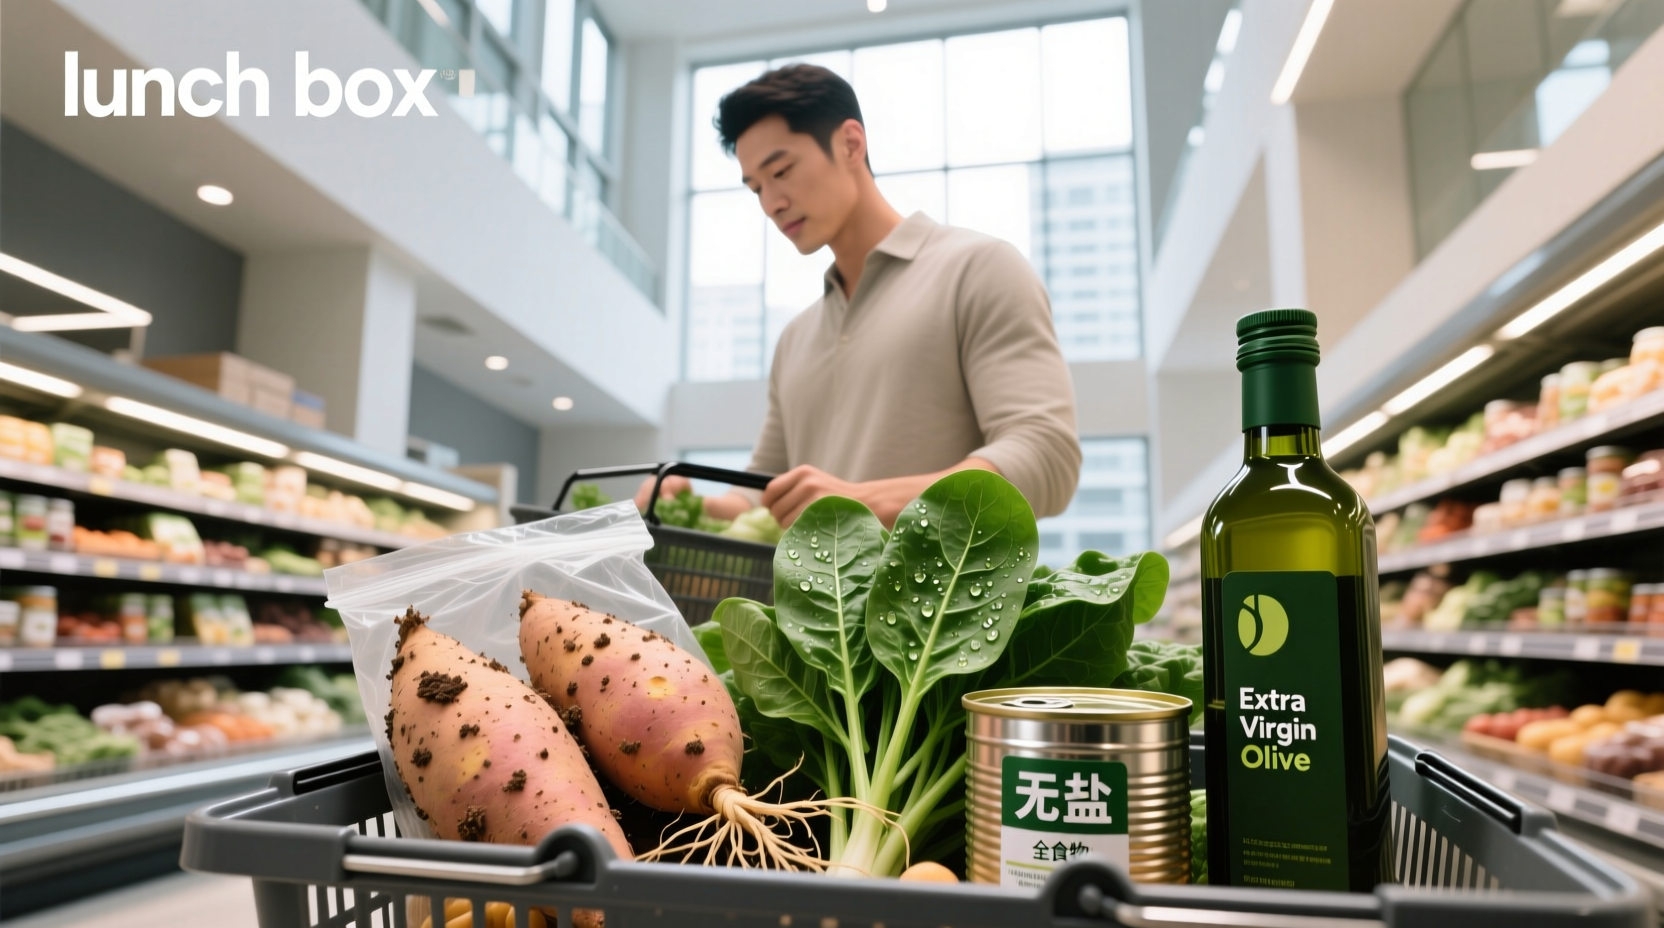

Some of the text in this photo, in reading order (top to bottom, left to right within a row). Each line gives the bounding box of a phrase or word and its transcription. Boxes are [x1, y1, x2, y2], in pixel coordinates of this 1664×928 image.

[1239, 687, 1306, 712] Extra
[1239, 715, 1317, 747] Virgin
[1240, 744, 1311, 772] Olive
[1014, 770, 1113, 825] 无盐
